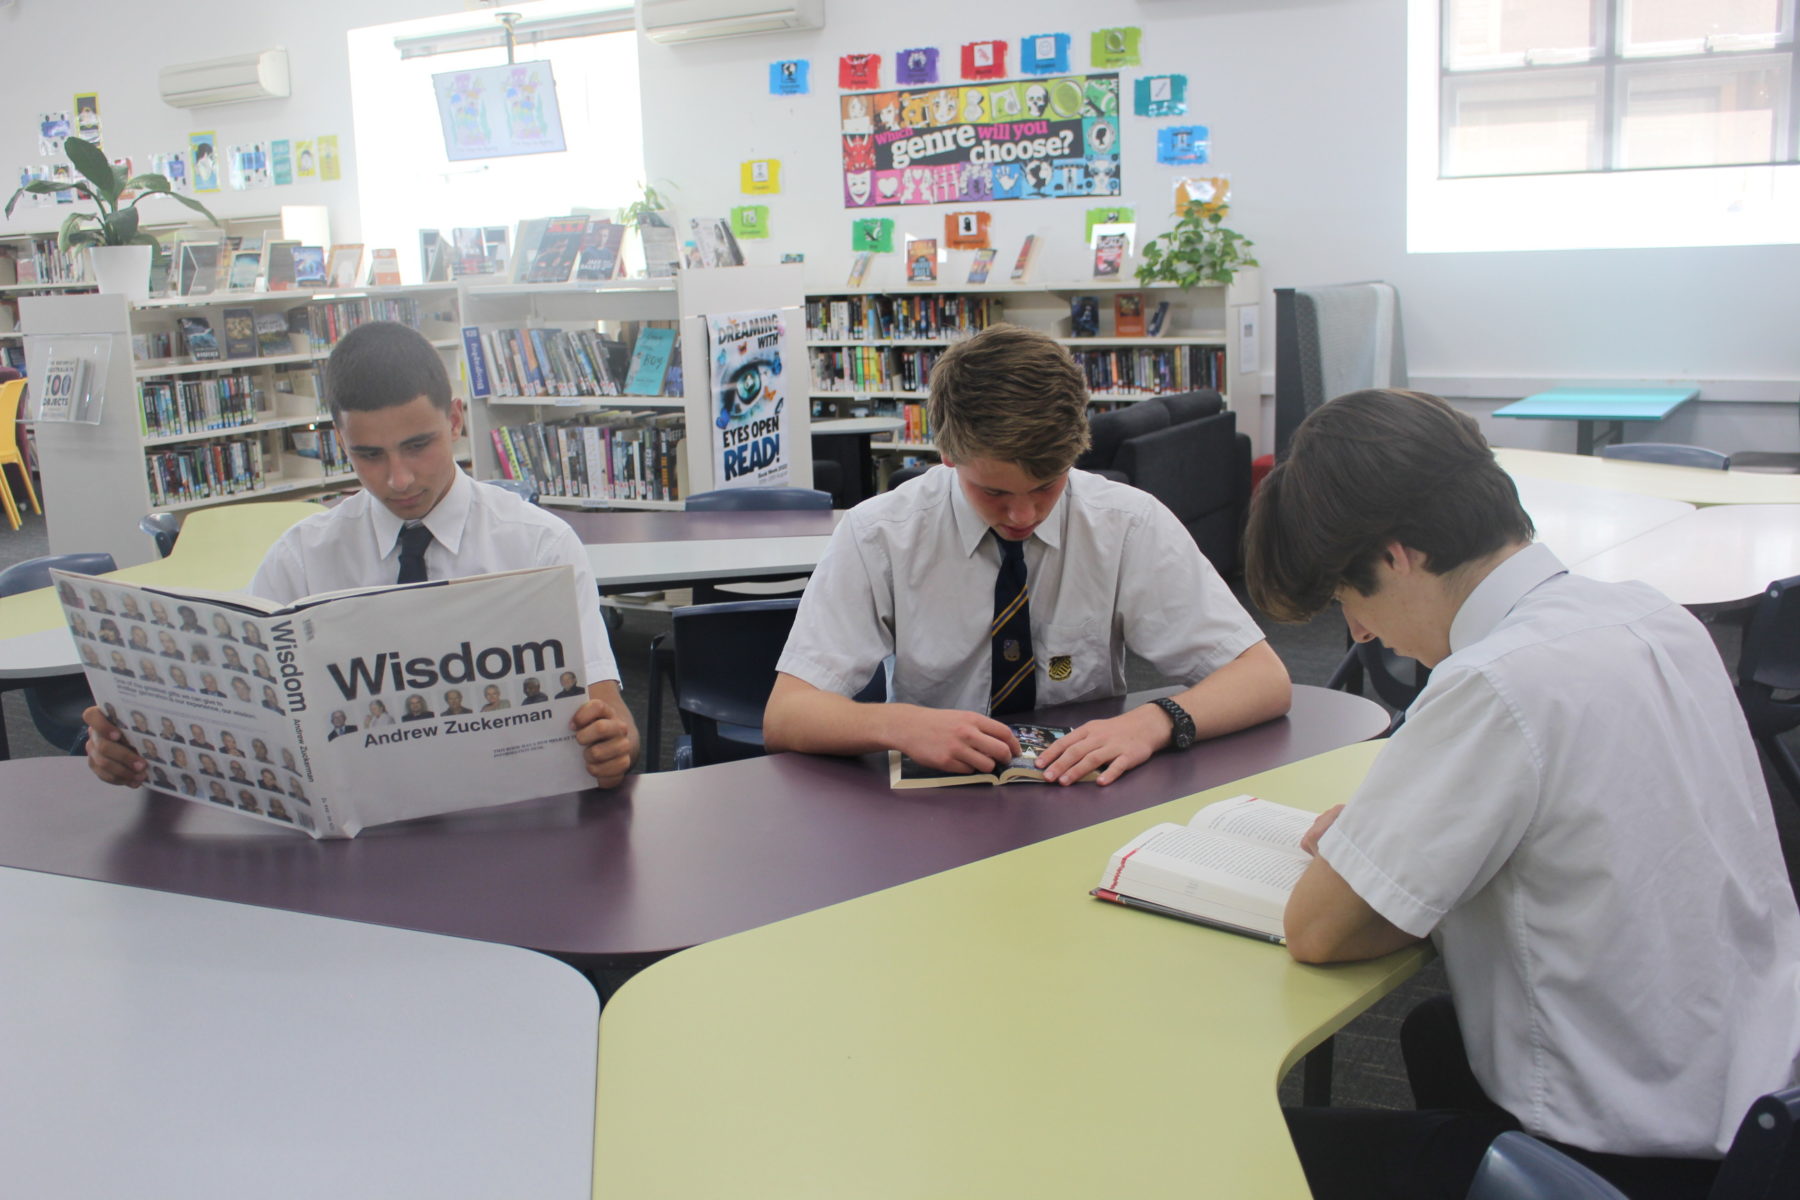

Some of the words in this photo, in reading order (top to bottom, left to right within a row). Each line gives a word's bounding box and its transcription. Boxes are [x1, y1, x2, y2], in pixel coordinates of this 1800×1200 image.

[874, 127, 914, 146] Which
[890, 124, 976, 169] genre
[977, 123, 1010, 141] will
[1011, 119, 1048, 141] you
[969, 130, 1074, 164] choose?
[718, 314, 779, 345] DREAMING
[757, 332, 779, 349] WITH
[45, 374, 72, 396] 100
[722, 426, 749, 449] EYES
[751, 415, 780, 439] OPEN
[723, 432, 780, 482] READ!
[269, 620, 307, 713] Wisdom
[327, 638, 565, 702] Wisdom
[364, 724, 438, 748] Andrew
[443, 707, 553, 735] Zuckerman
[293, 718, 305, 745] Andrew
[299, 746, 315, 783] Zuckerman
